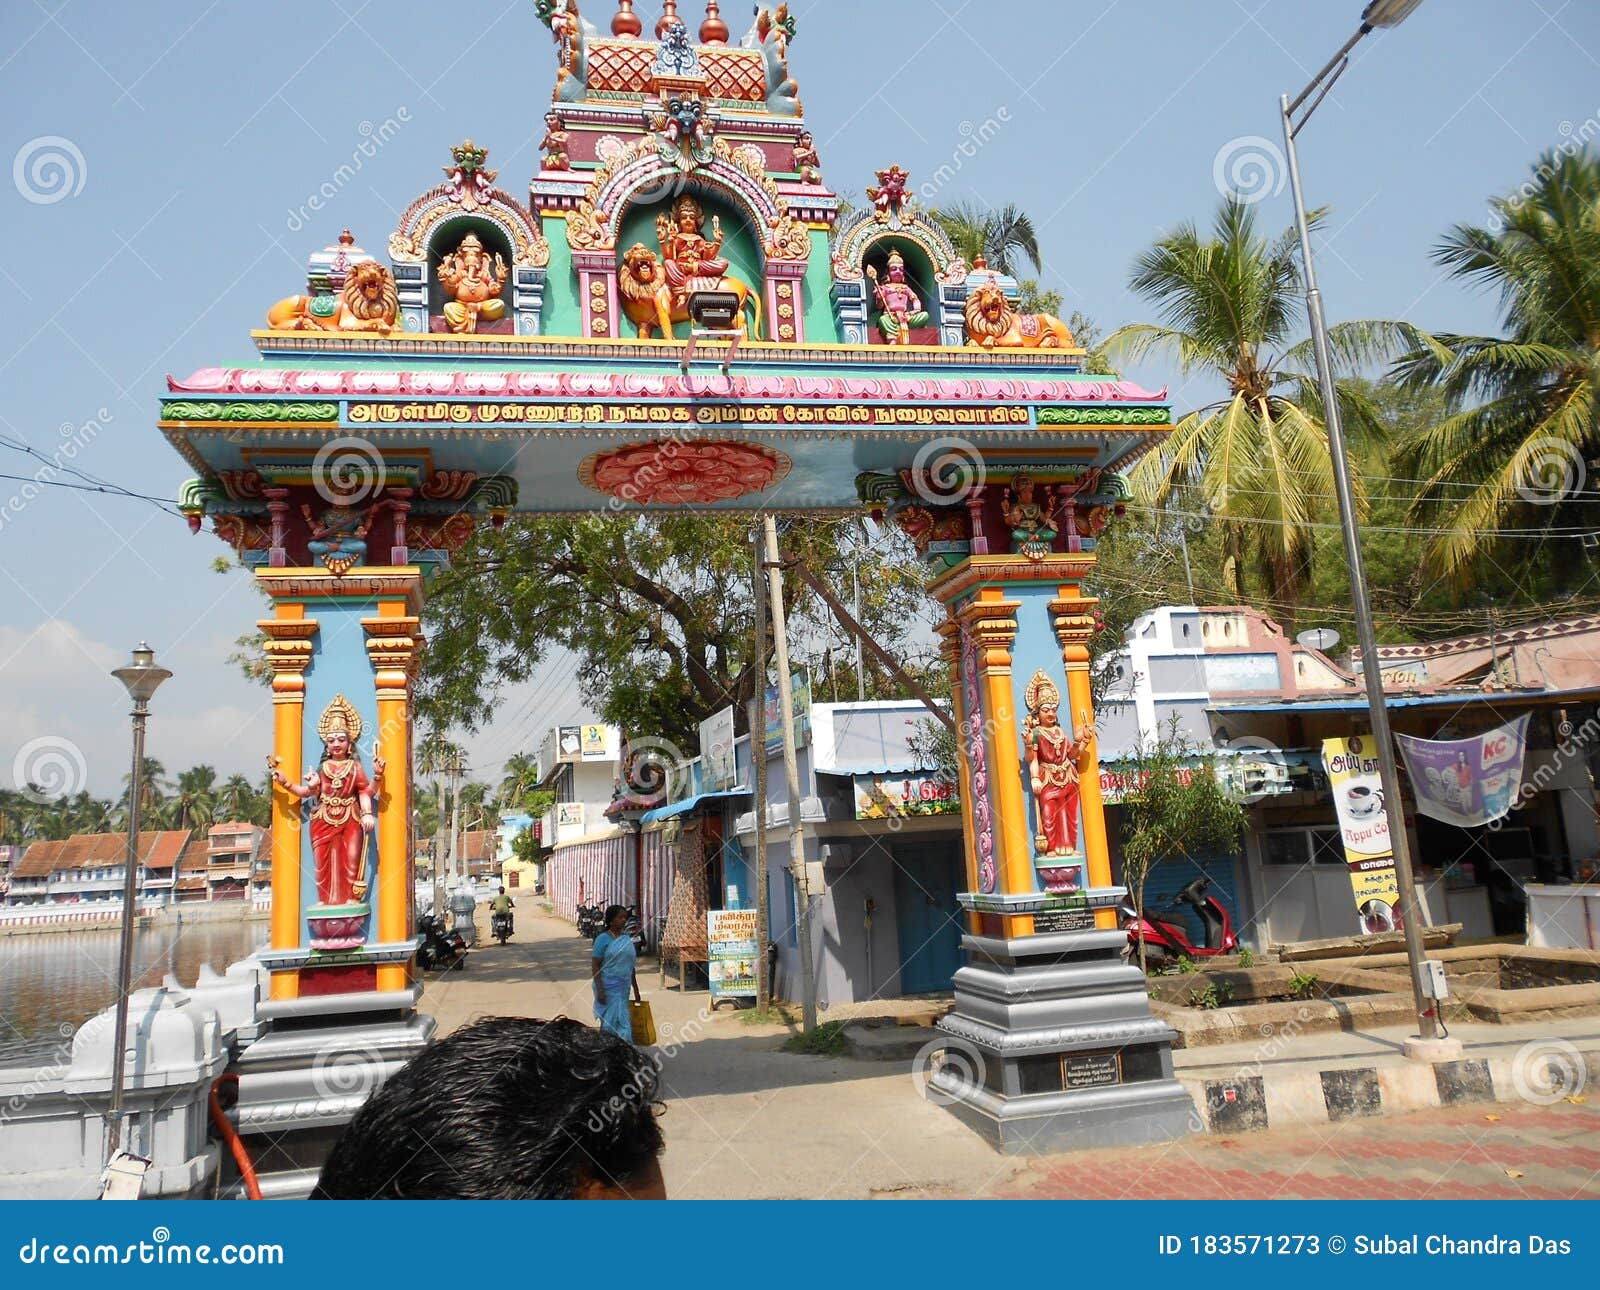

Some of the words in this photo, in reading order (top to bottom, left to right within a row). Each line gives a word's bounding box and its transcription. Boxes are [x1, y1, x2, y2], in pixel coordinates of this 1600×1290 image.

[349, 403, 472, 423] அருள்மிகு
[608, 404, 690, 424] நங்கை
[696, 403, 778, 424] அம்மன்
[781, 404, 869, 423] கோவில்
[1331, 753, 1361, 773] அப்பு
